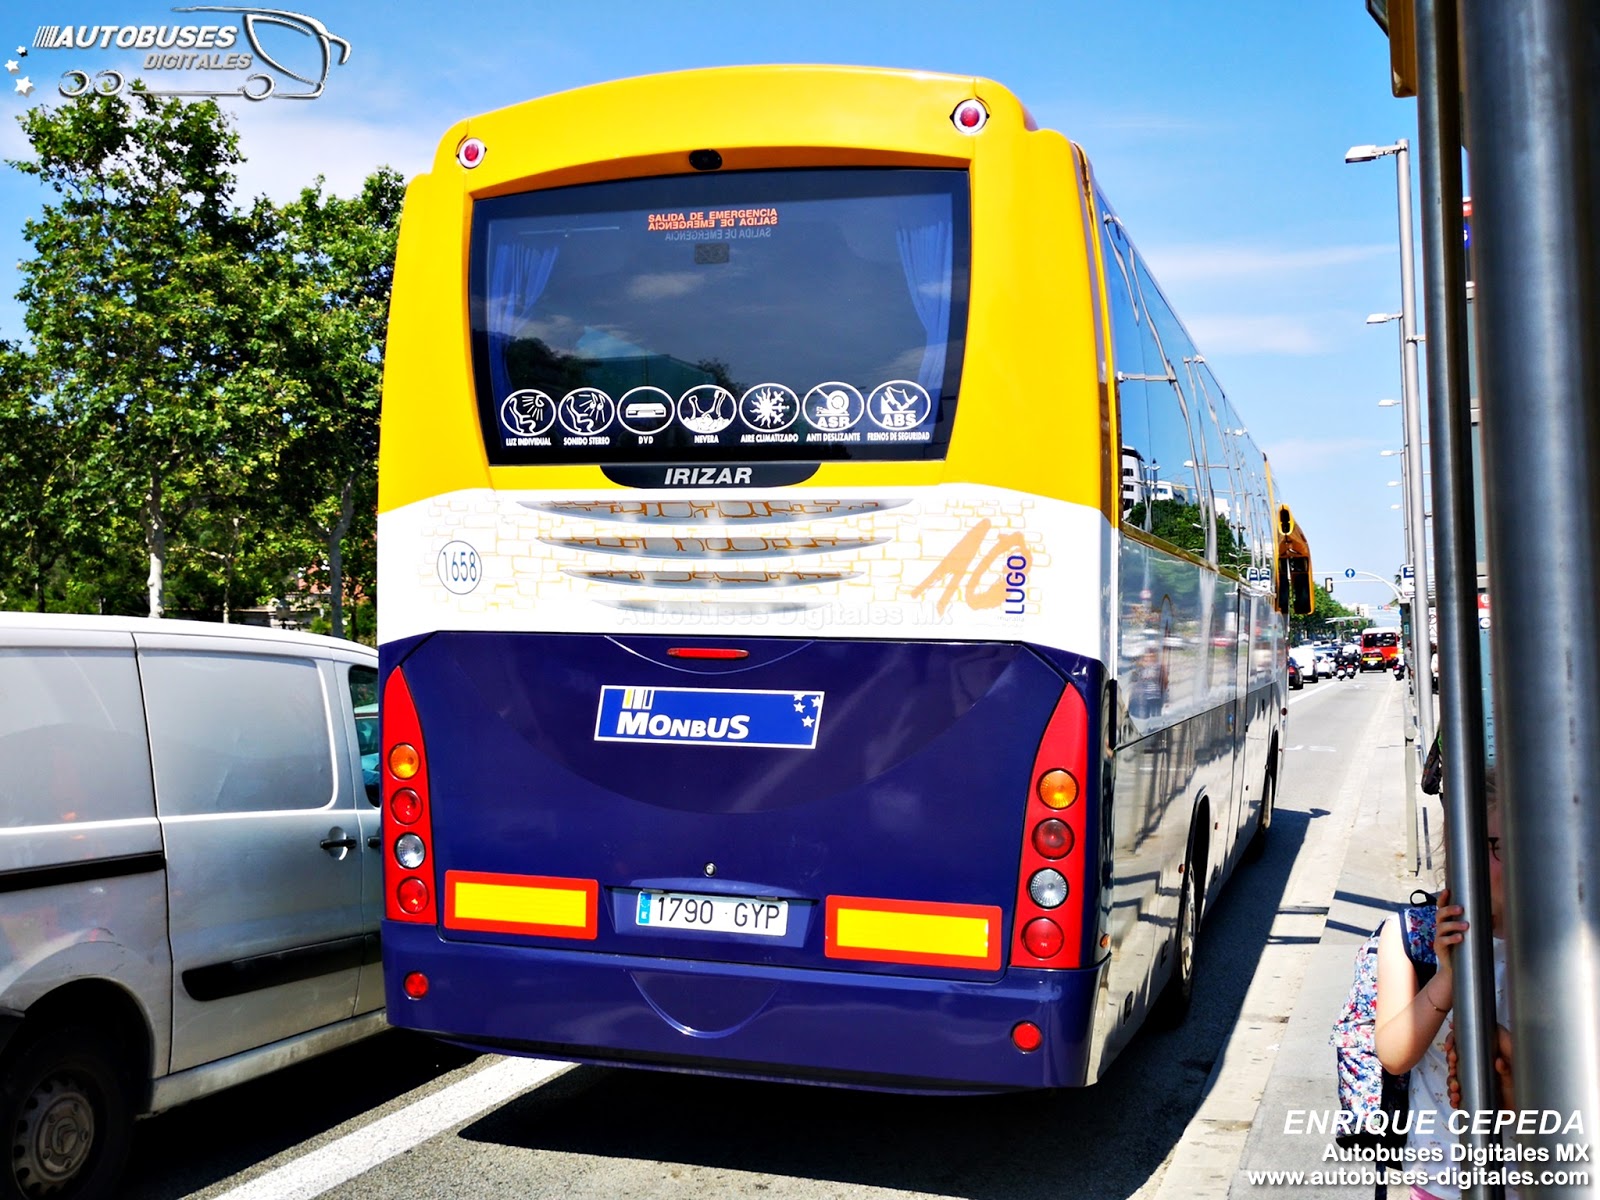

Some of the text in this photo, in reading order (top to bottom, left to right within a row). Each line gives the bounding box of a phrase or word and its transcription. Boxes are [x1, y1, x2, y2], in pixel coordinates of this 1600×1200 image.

[648, 208, 778, 223] SALIDA DE EMERGENCIA
[817, 416, 850, 428] ASR
[882, 413, 917, 427] ABS
[505, 437, 552, 446] LUZ INDIVIDUAL
[563, 436, 611, 446] SONIDO STEREO
[638, 436, 654, 445] DVD
[694, 434, 719, 444] NEVERA
[740, 433, 799, 443] AIRE CLIMATIZADO
[806, 432, 861, 442] ANTI DESLIZANTE
[867, 431, 930, 441] FRENOS DE SEGURIDAD
[664, 467, 753, 485] IRIZAR
[443, 551, 477, 582] 1658
[1005, 555, 1027, 615] LUGO
[658, 896, 780, 929] 1790 GYP
